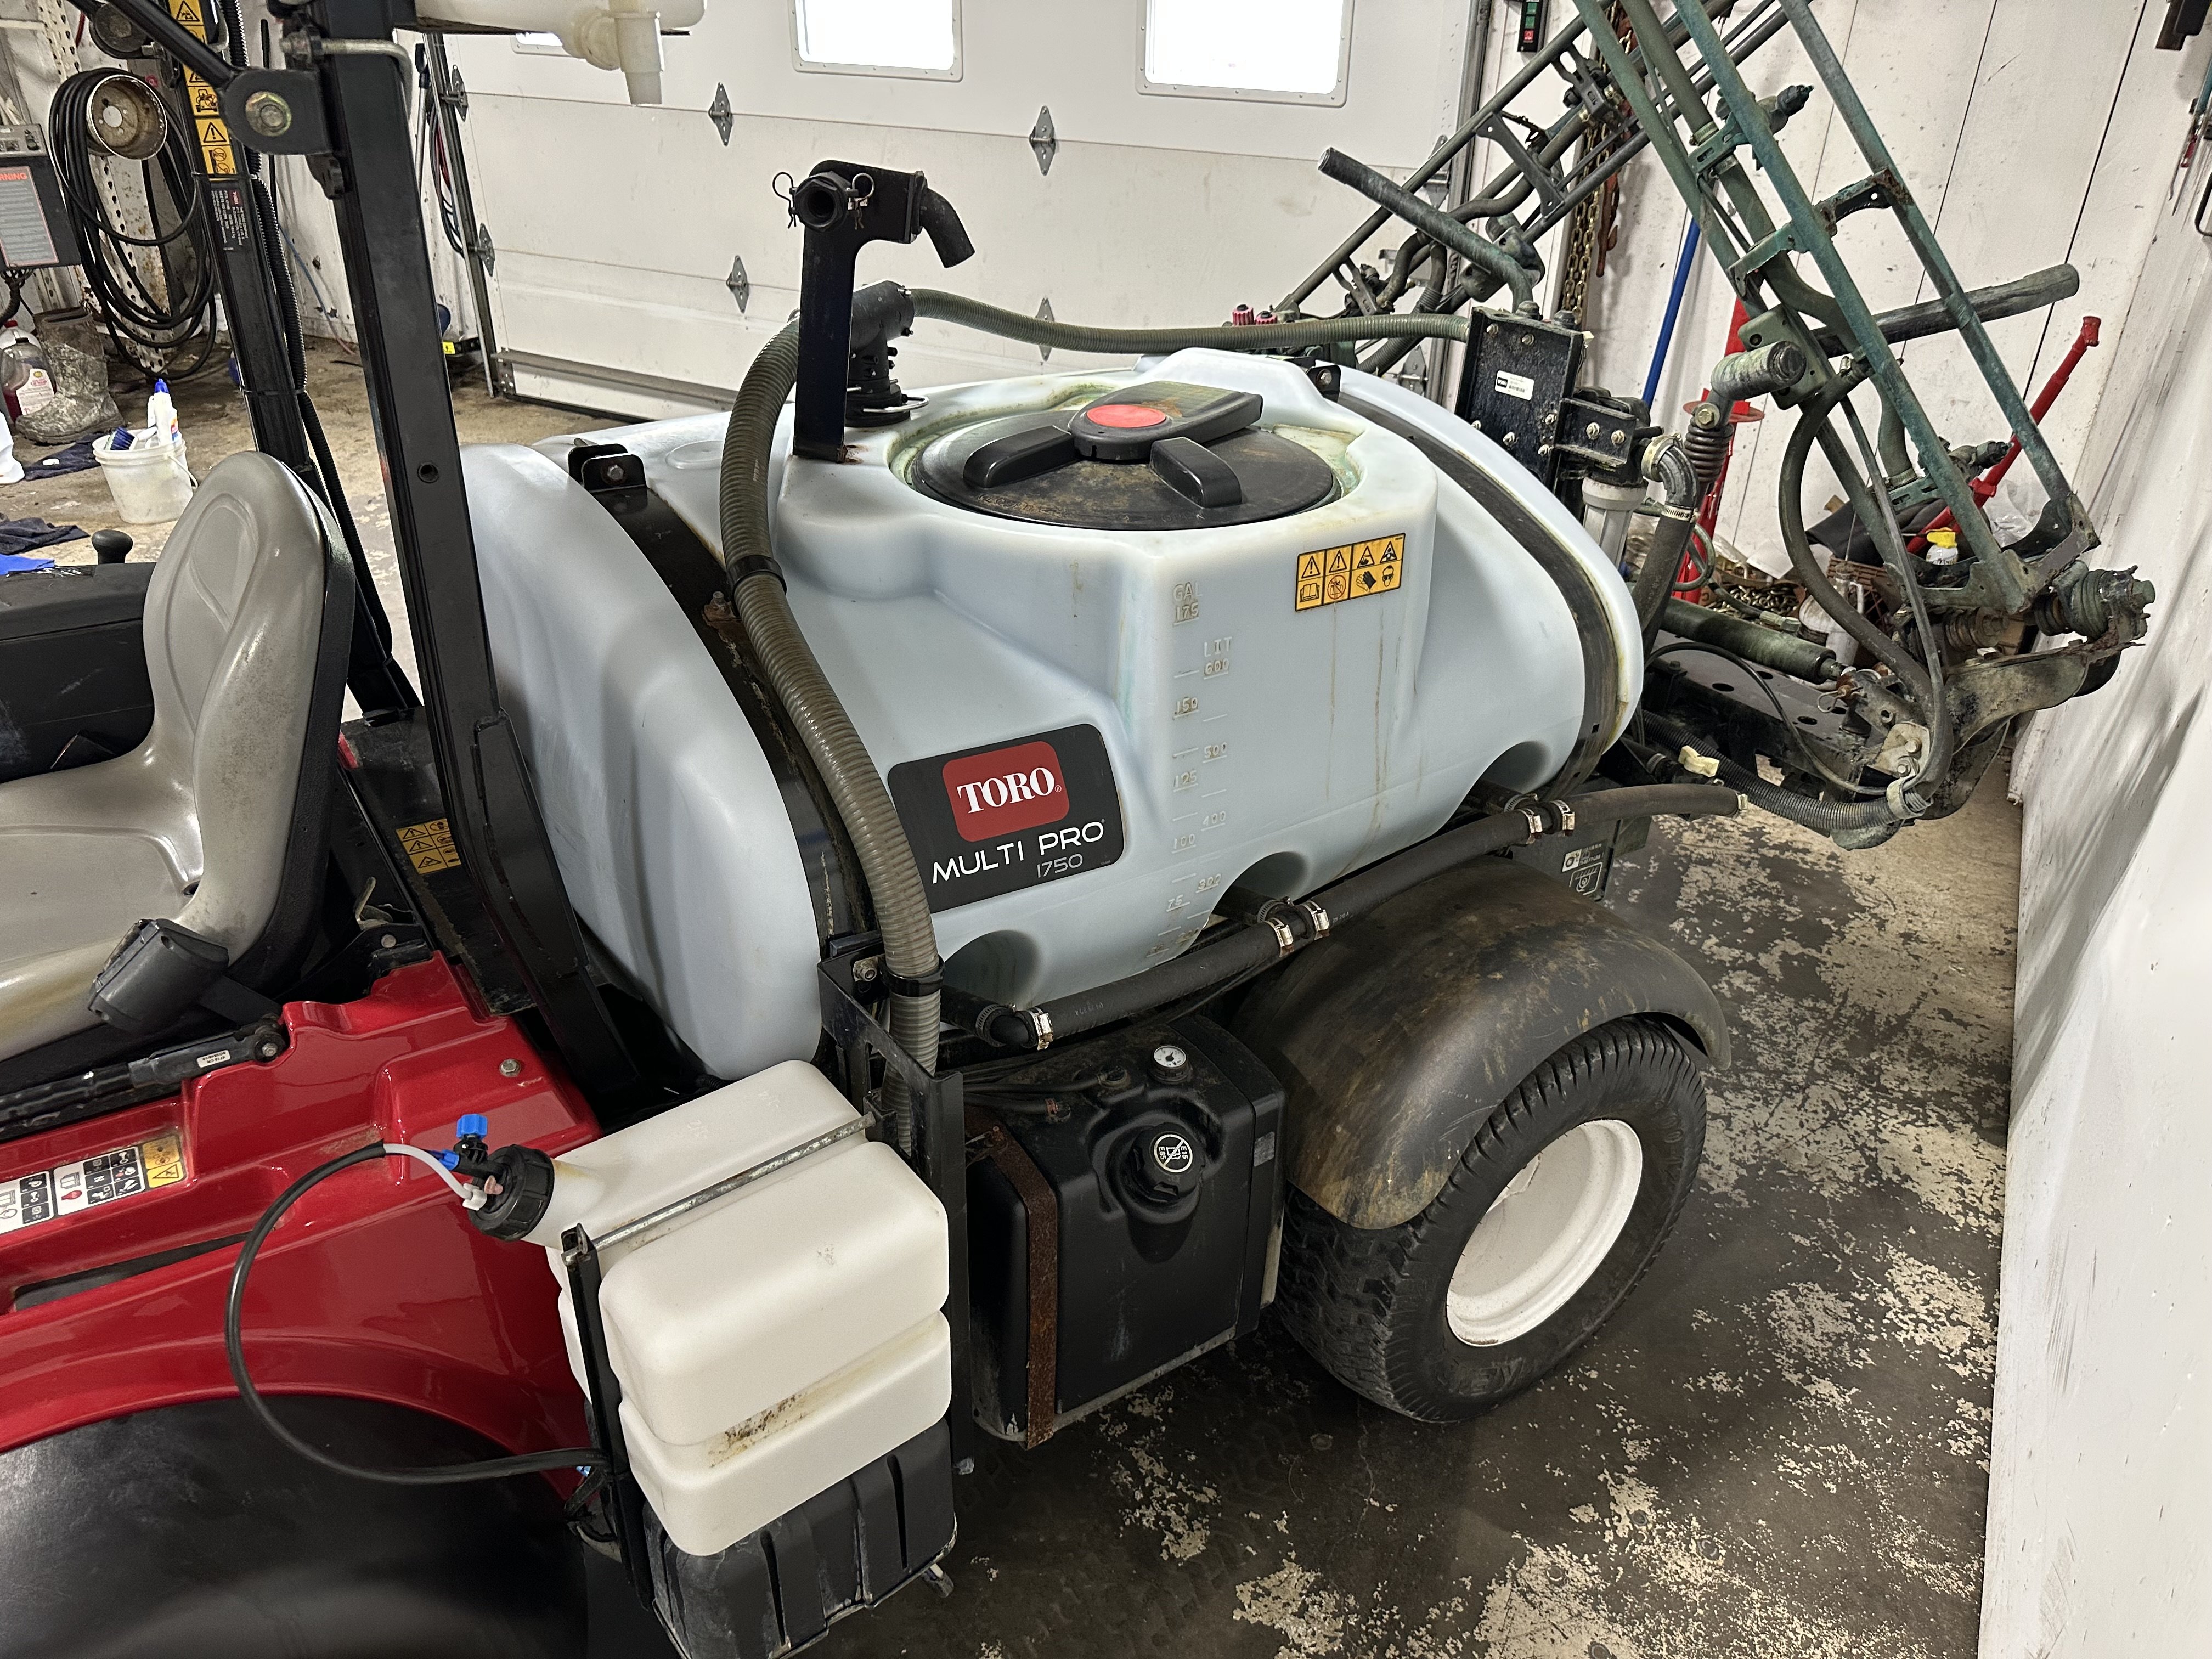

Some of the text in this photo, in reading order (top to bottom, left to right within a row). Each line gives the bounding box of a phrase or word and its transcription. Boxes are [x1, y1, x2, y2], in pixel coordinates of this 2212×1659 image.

[1173, 582, 1203, 601] GAL
[1176, 602, 1199, 621] 175
[1204, 636, 1232, 657] LIT
[1205, 658, 1229, 675] 600
[1176, 697, 1198, 714] 150
[1204, 743, 1227, 759] 500
[1174, 770, 1197, 788] 125
[956, 767, 1056, 814] TORO
[1203, 811, 1226, 826] 400
[1174, 834, 1195, 850] 100
[933, 821, 1104, 884] MULTI PRO
[1037, 854, 1084, 878] 1750
[1198, 873, 1221, 890] 300
[1167, 894, 1184, 909] 75
[1158, 1146, 1167, 1160] E85
[1181, 1146, 1189, 1159] E15
